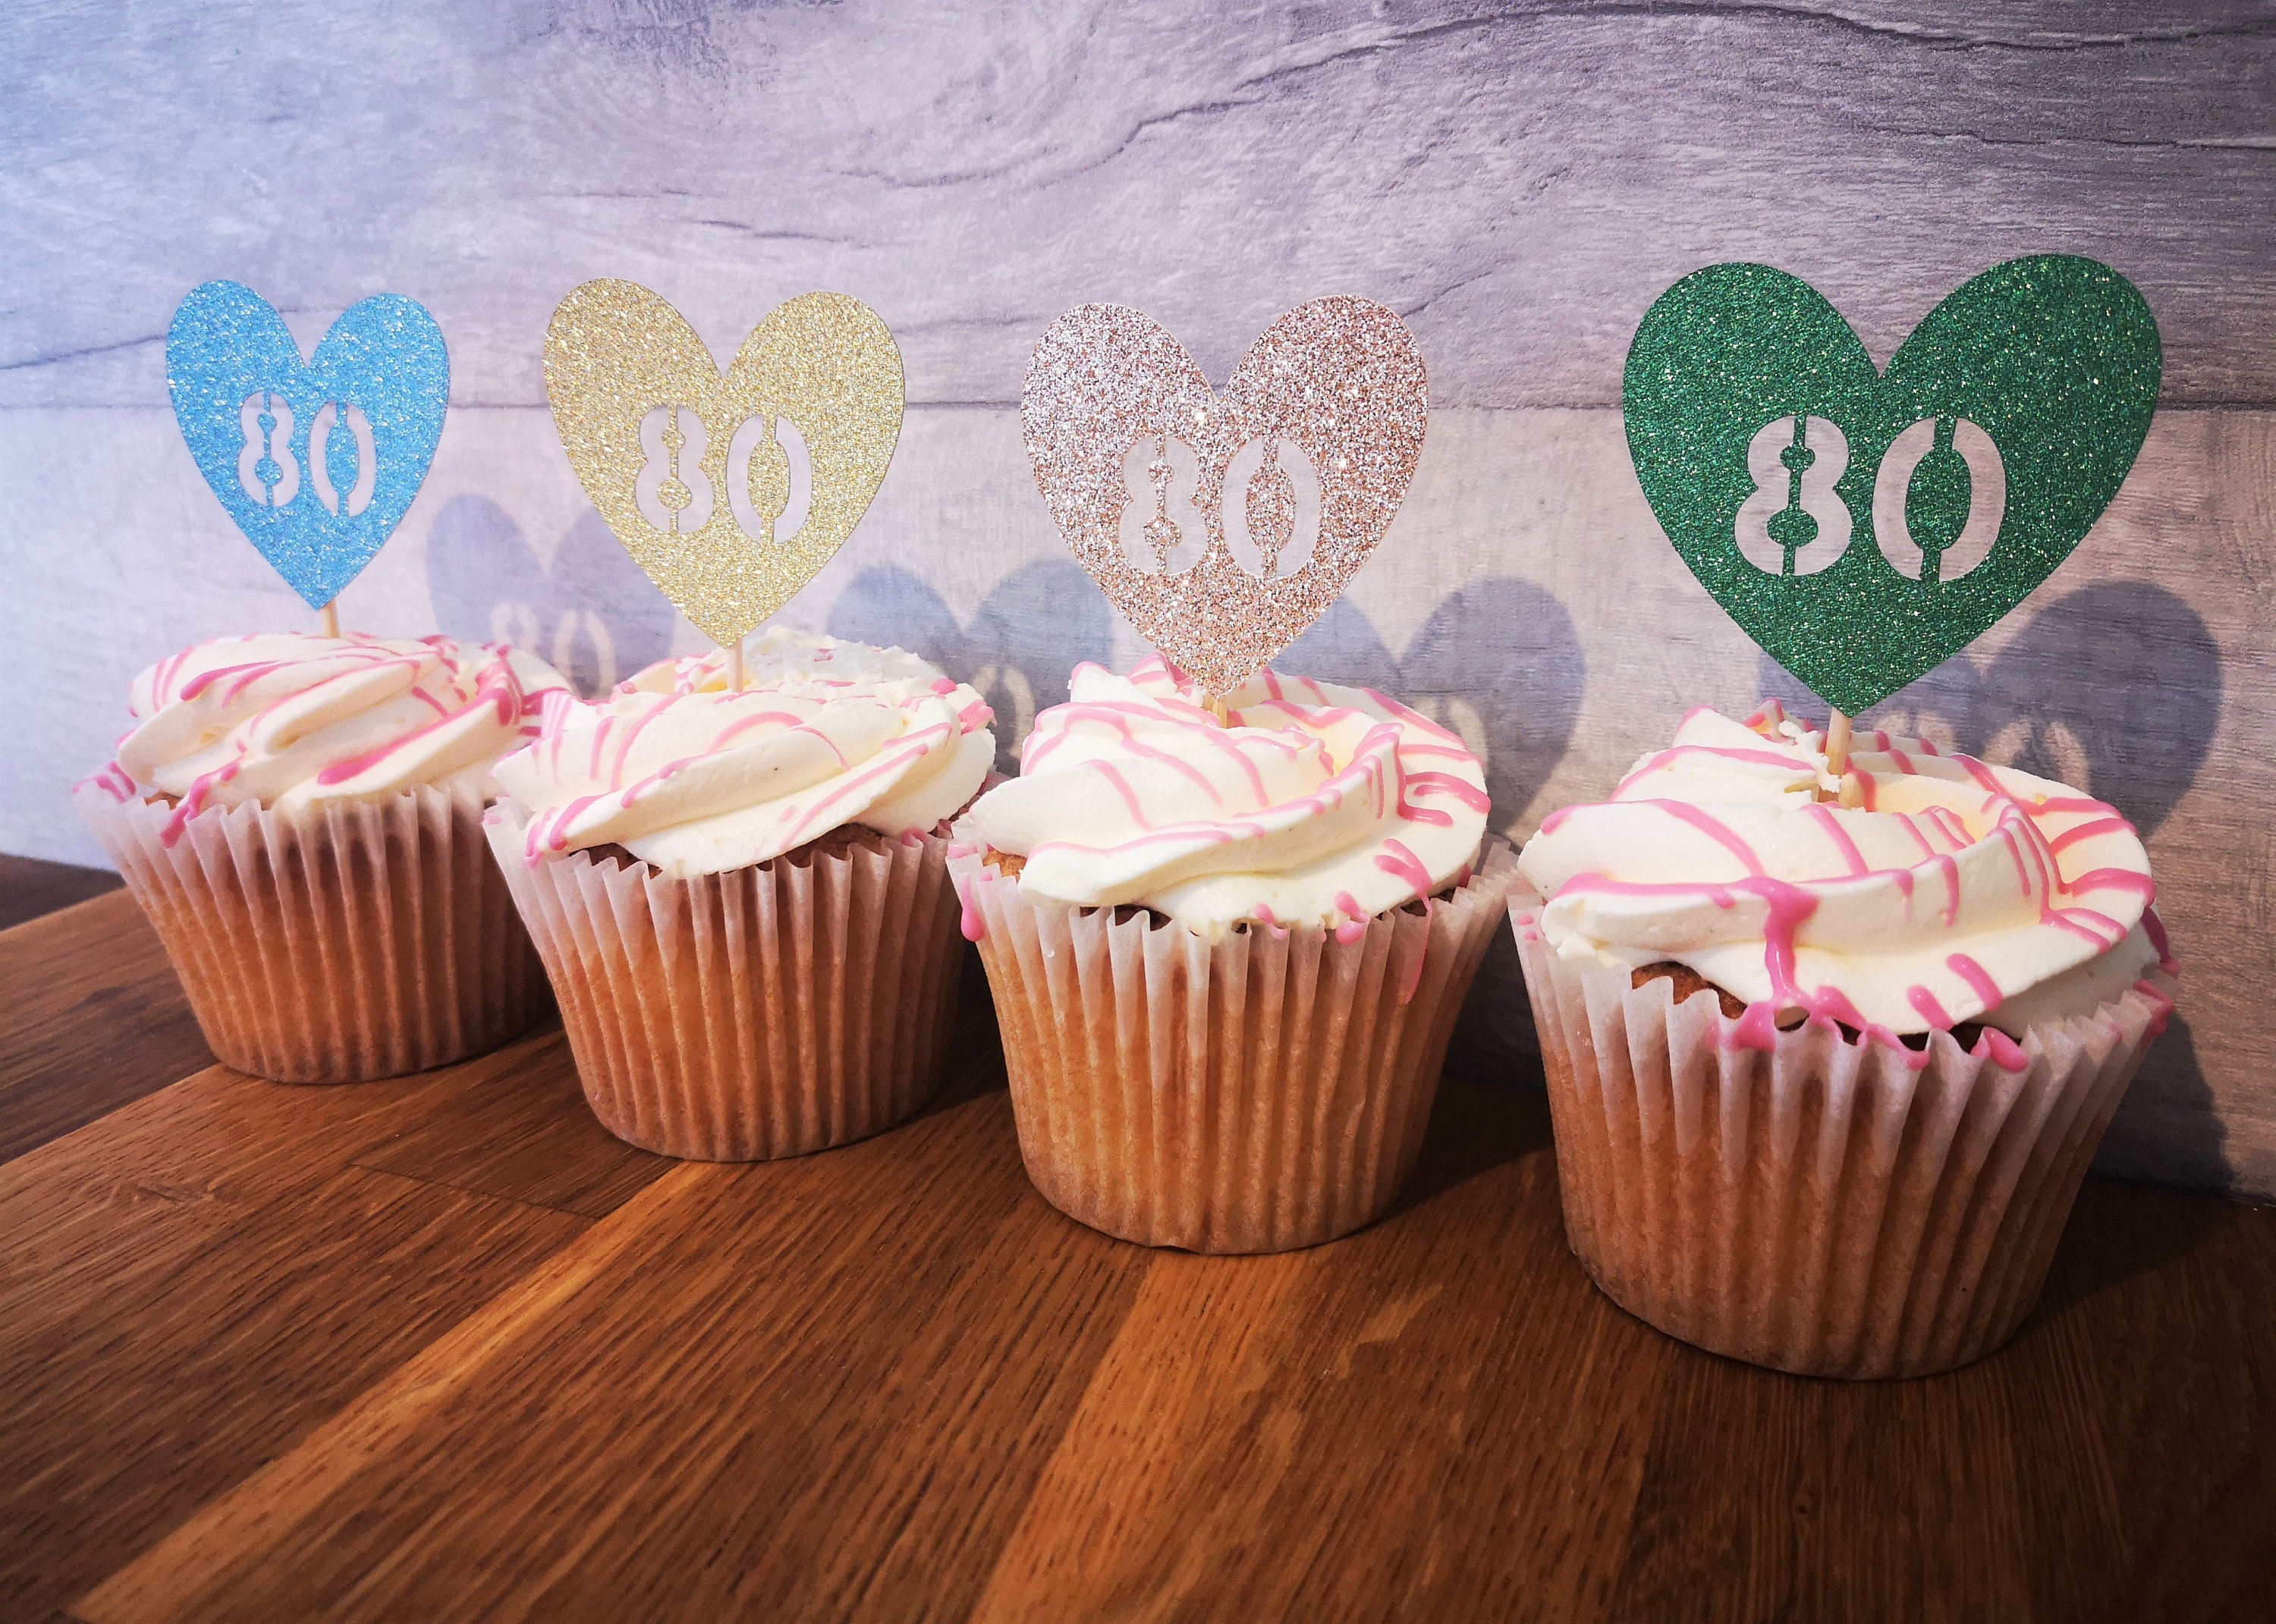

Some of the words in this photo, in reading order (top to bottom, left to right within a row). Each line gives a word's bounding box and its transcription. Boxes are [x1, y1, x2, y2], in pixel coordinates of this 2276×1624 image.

[239, 391, 376, 517] 80
[635, 405, 813, 544] 80
[1119, 435, 1322, 578] 80
[1734, 414, 2007, 583] 80
